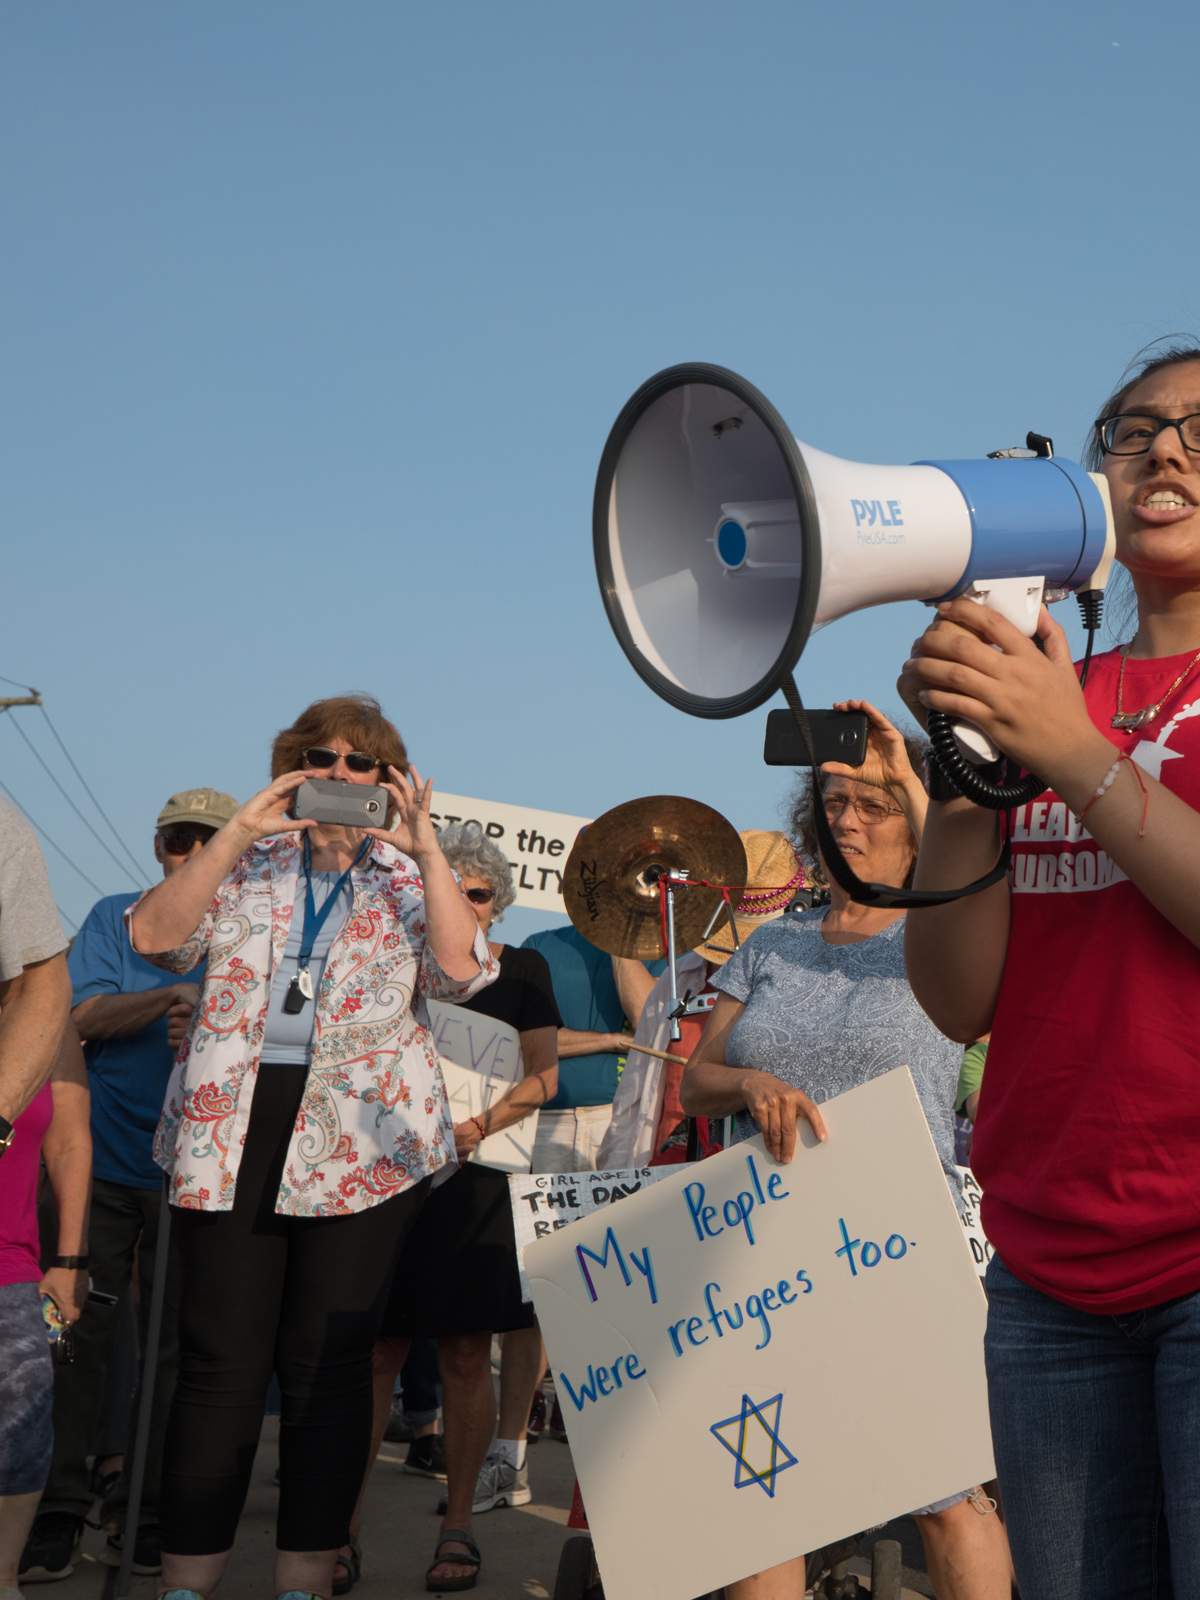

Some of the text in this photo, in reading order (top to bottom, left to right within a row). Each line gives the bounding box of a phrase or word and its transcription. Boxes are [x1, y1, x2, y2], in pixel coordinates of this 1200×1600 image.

[850, 498, 904, 527] PYLE
[517, 829, 566, 857] the
[1010, 850, 1122, 891] UDSON
[535, 1167, 651, 1189] GIRL AGE 16
[520, 1187, 581, 1214] THE
[574, 1155, 790, 1304] My People
[560, 1217, 917, 1411] Were refugees too.
